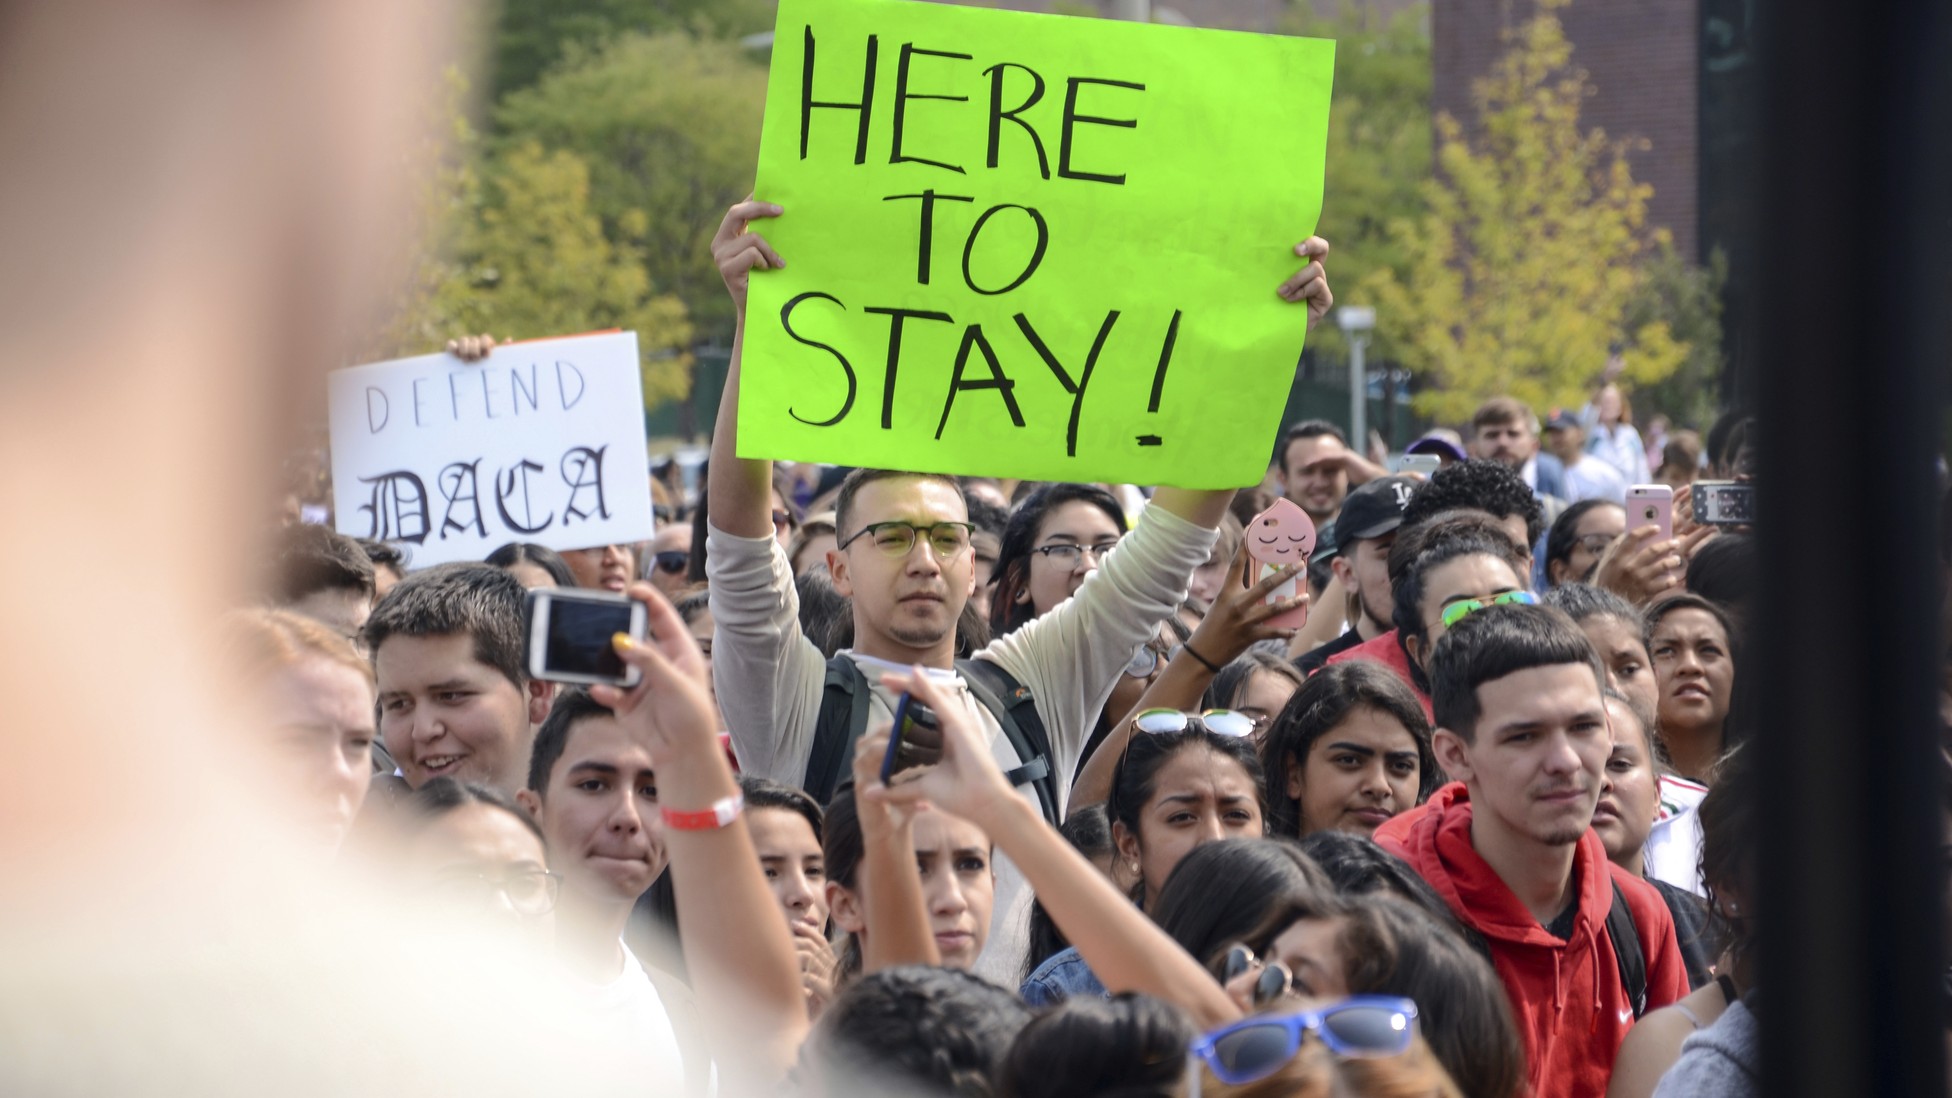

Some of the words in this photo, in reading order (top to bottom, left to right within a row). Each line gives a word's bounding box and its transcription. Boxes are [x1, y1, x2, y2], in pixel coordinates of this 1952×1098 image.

[799, 24, 1146, 185] HERE
[882, 189, 1049, 296] TO
[366, 360, 585, 435] DEFEND
[780, 291, 1182, 458] STAY!
[357, 443, 613, 547] DACA
